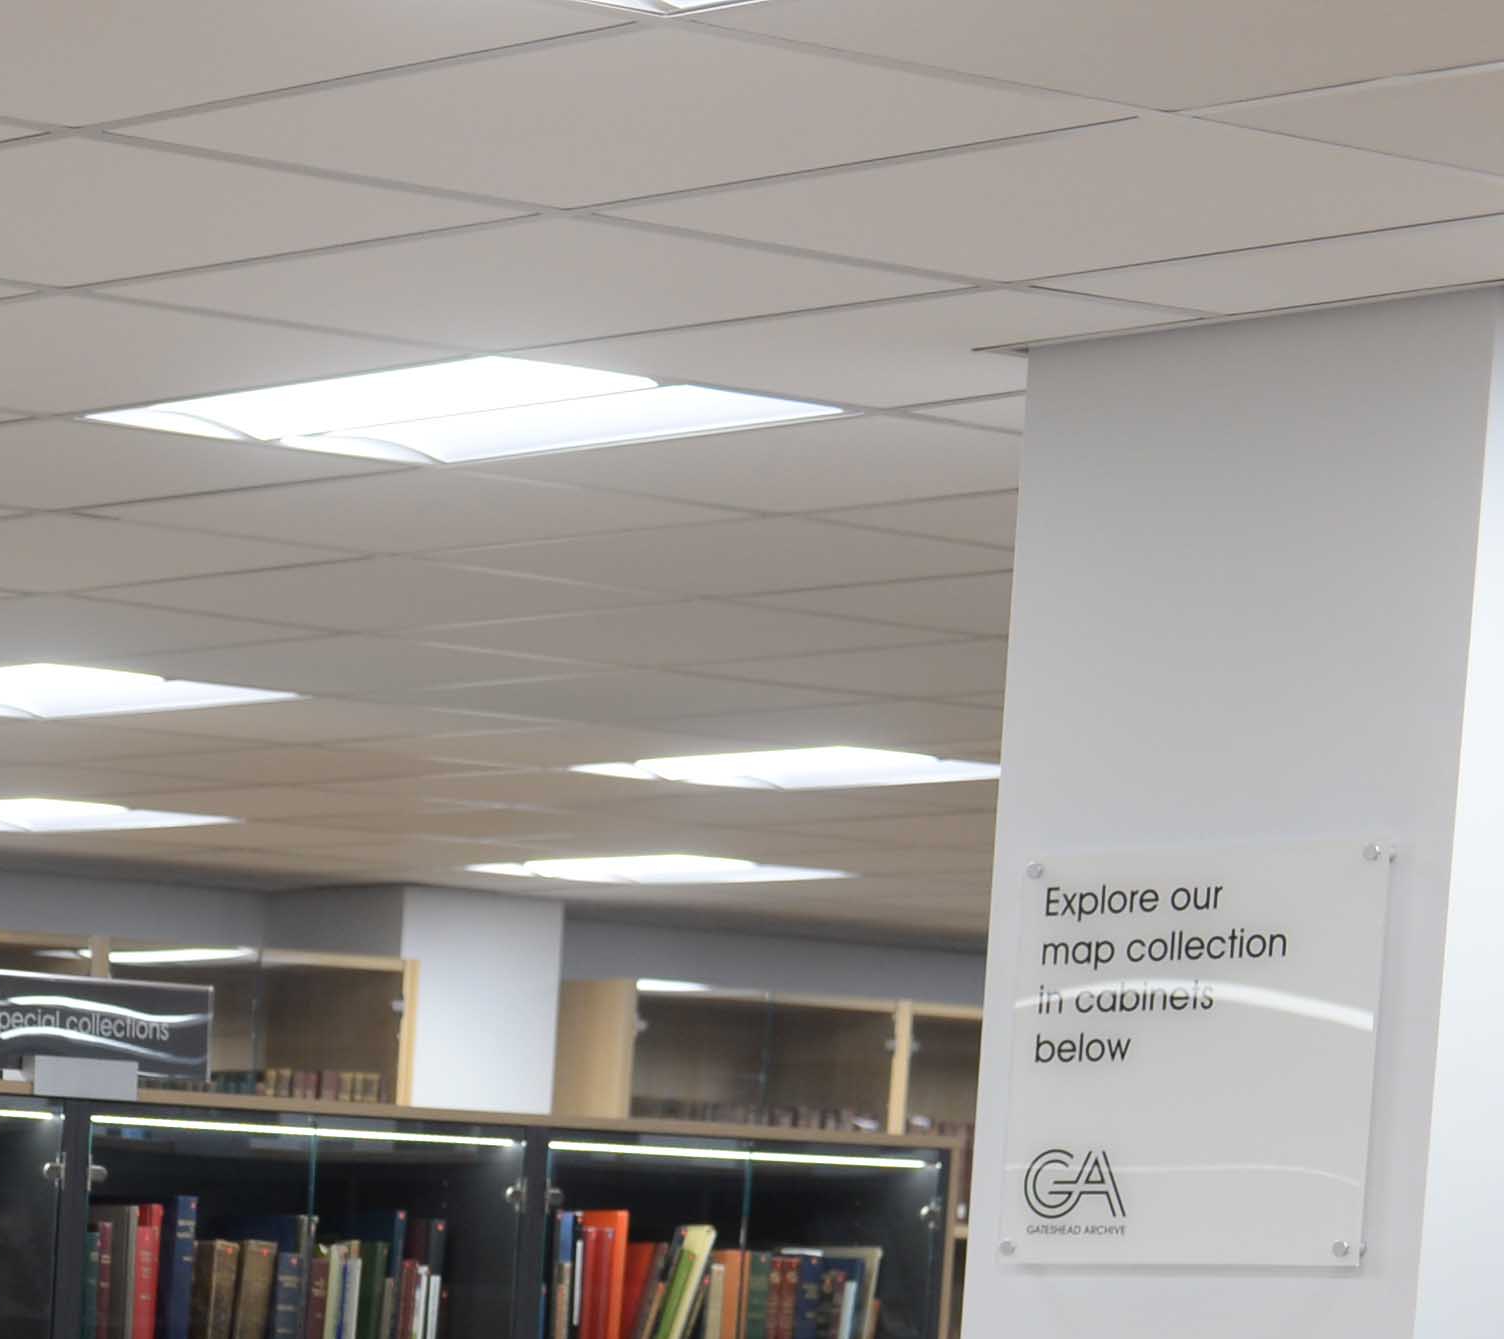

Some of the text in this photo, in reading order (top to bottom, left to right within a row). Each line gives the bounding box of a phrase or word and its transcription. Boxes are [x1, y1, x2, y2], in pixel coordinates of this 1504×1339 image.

[1044, 882, 1223, 922] Explore our
[1041, 927, 1288, 971] map collection
[1037, 979, 1215, 1015] in cabinets
[66, 1011, 170, 1041] collections
[1034, 1033, 1131, 1064] below
[1024, 1149, 1126, 1219] GA
[1026, 1224, 1126, 1236] GATESHEAD ARCHIVE
